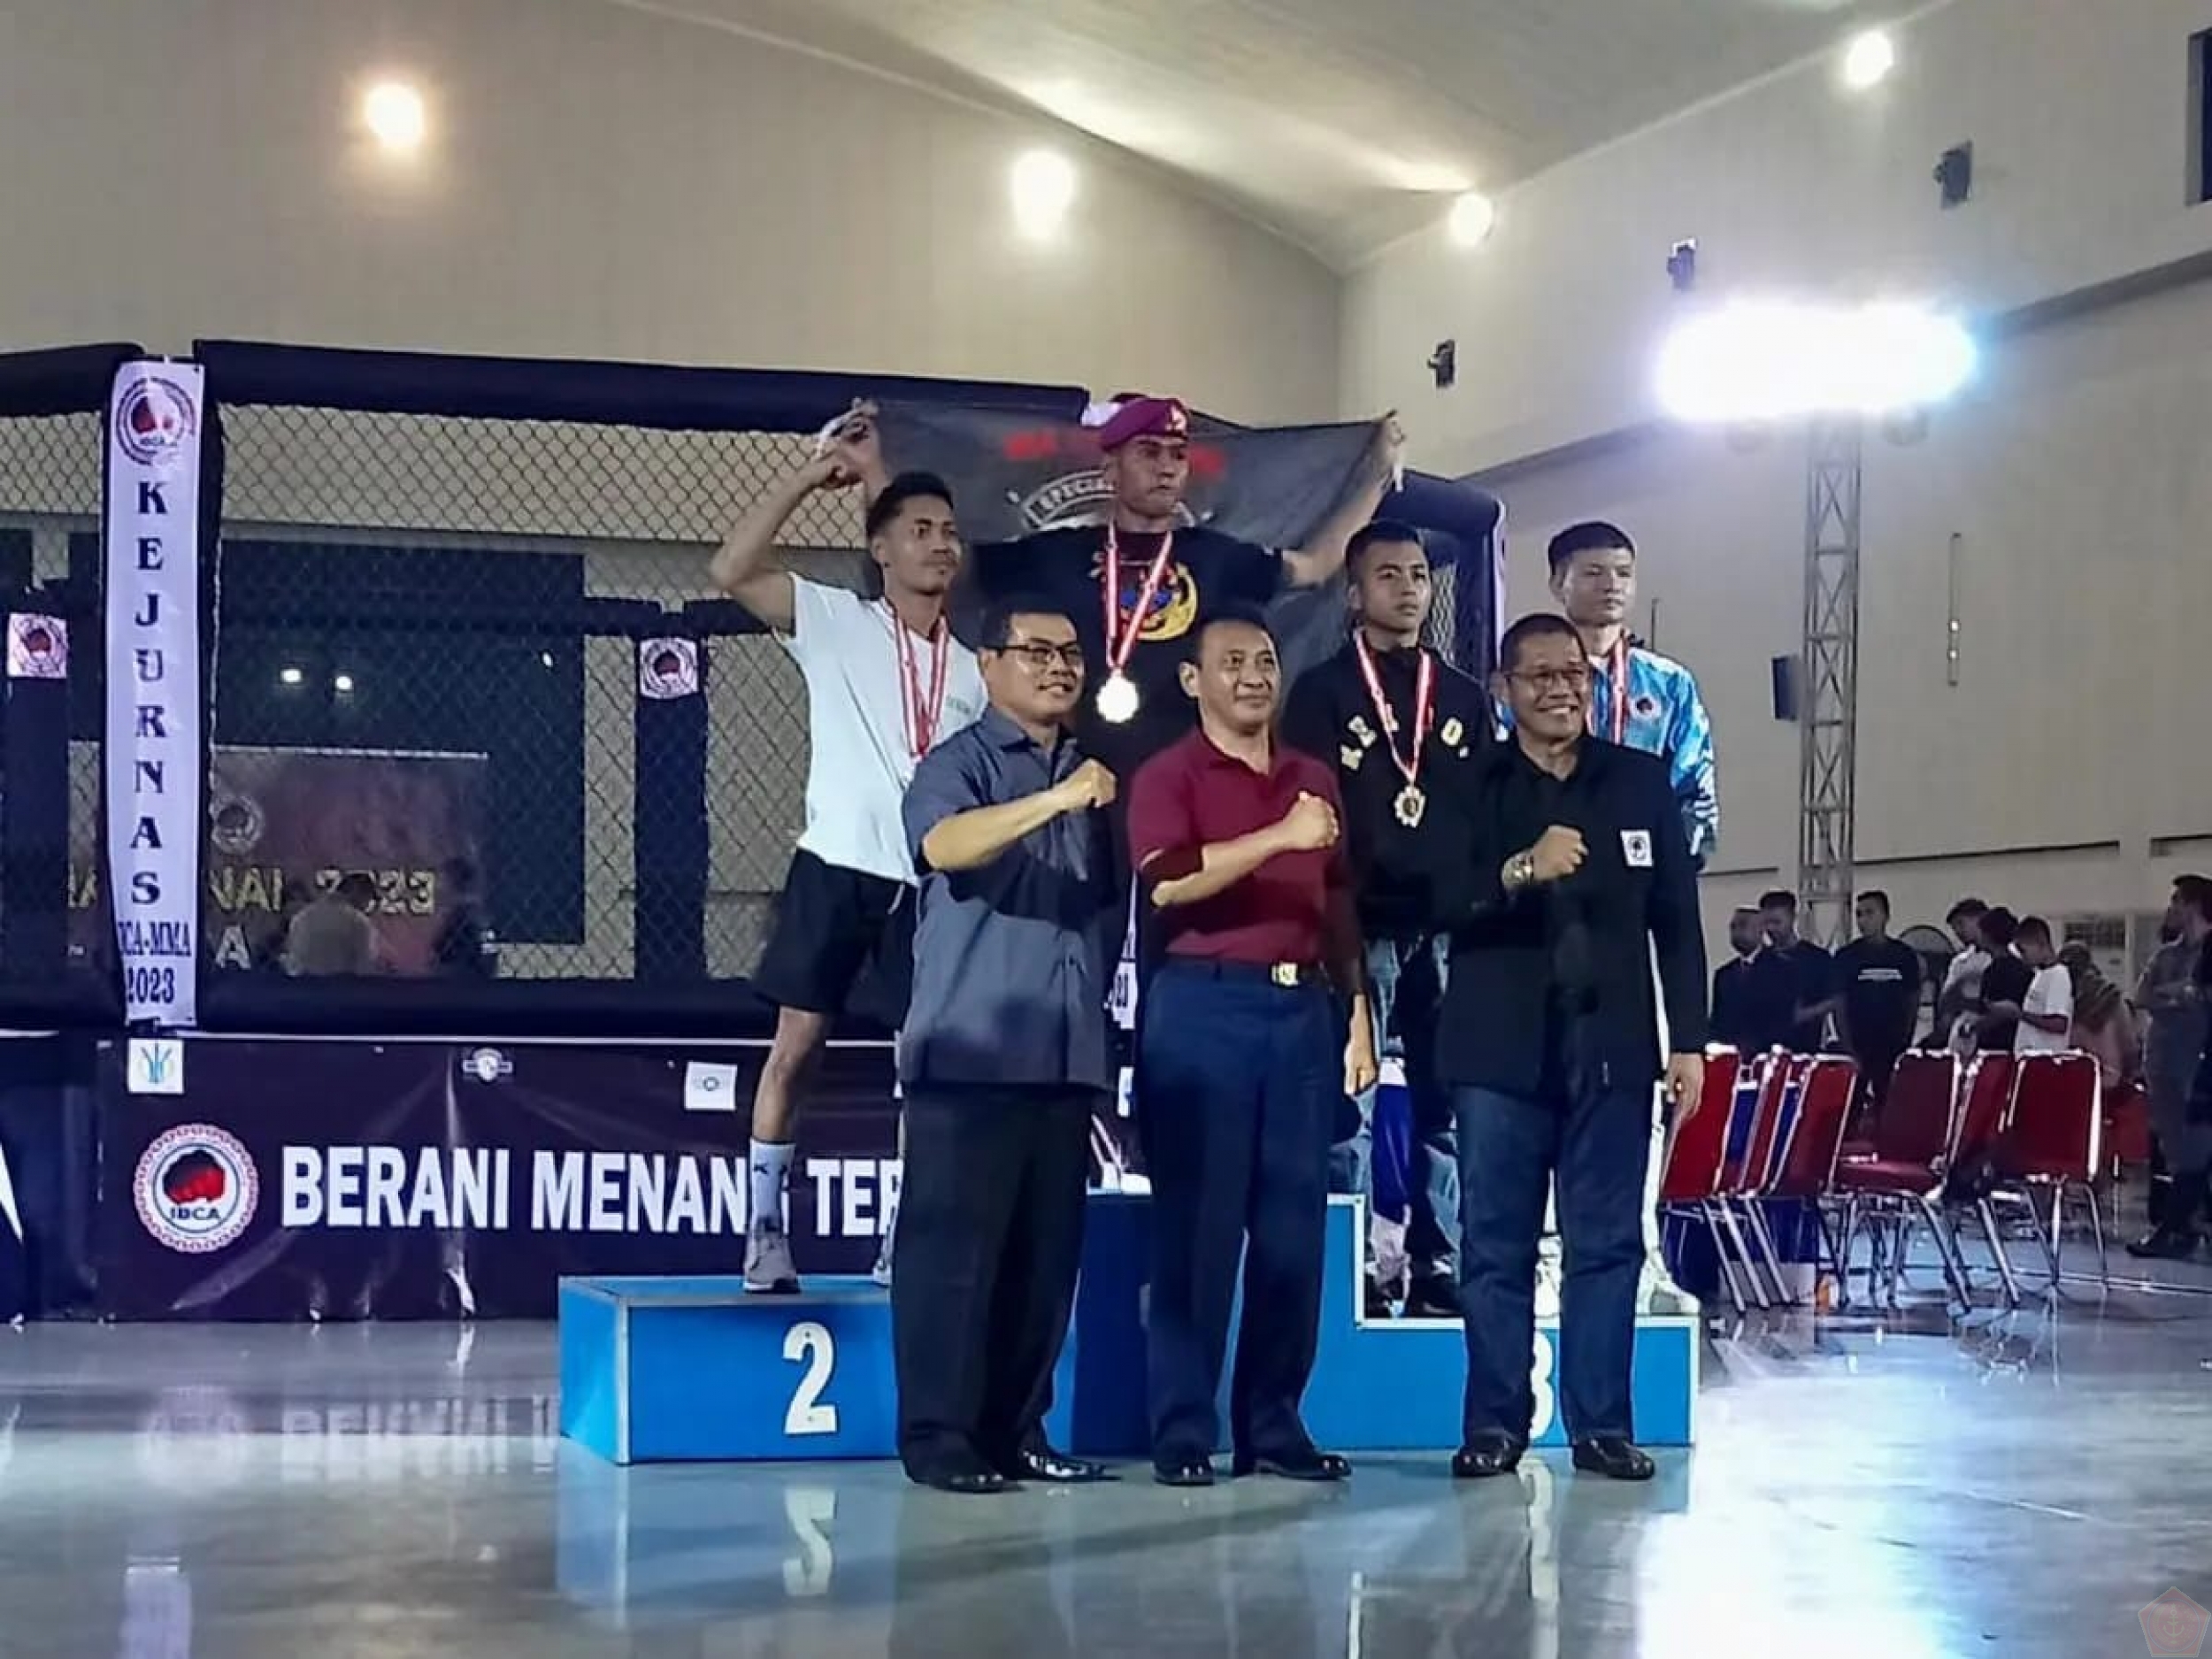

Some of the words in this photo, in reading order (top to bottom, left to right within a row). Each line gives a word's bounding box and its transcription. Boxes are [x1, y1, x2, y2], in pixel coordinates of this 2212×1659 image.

[130, 480, 168, 904] KEJURNAS
[170, 1207, 220, 1220] IBCA
[281, 1146, 510, 1228] BERANI
[531, 1150, 789, 1235] MENAN
[782, 1321, 837, 1434] 2
